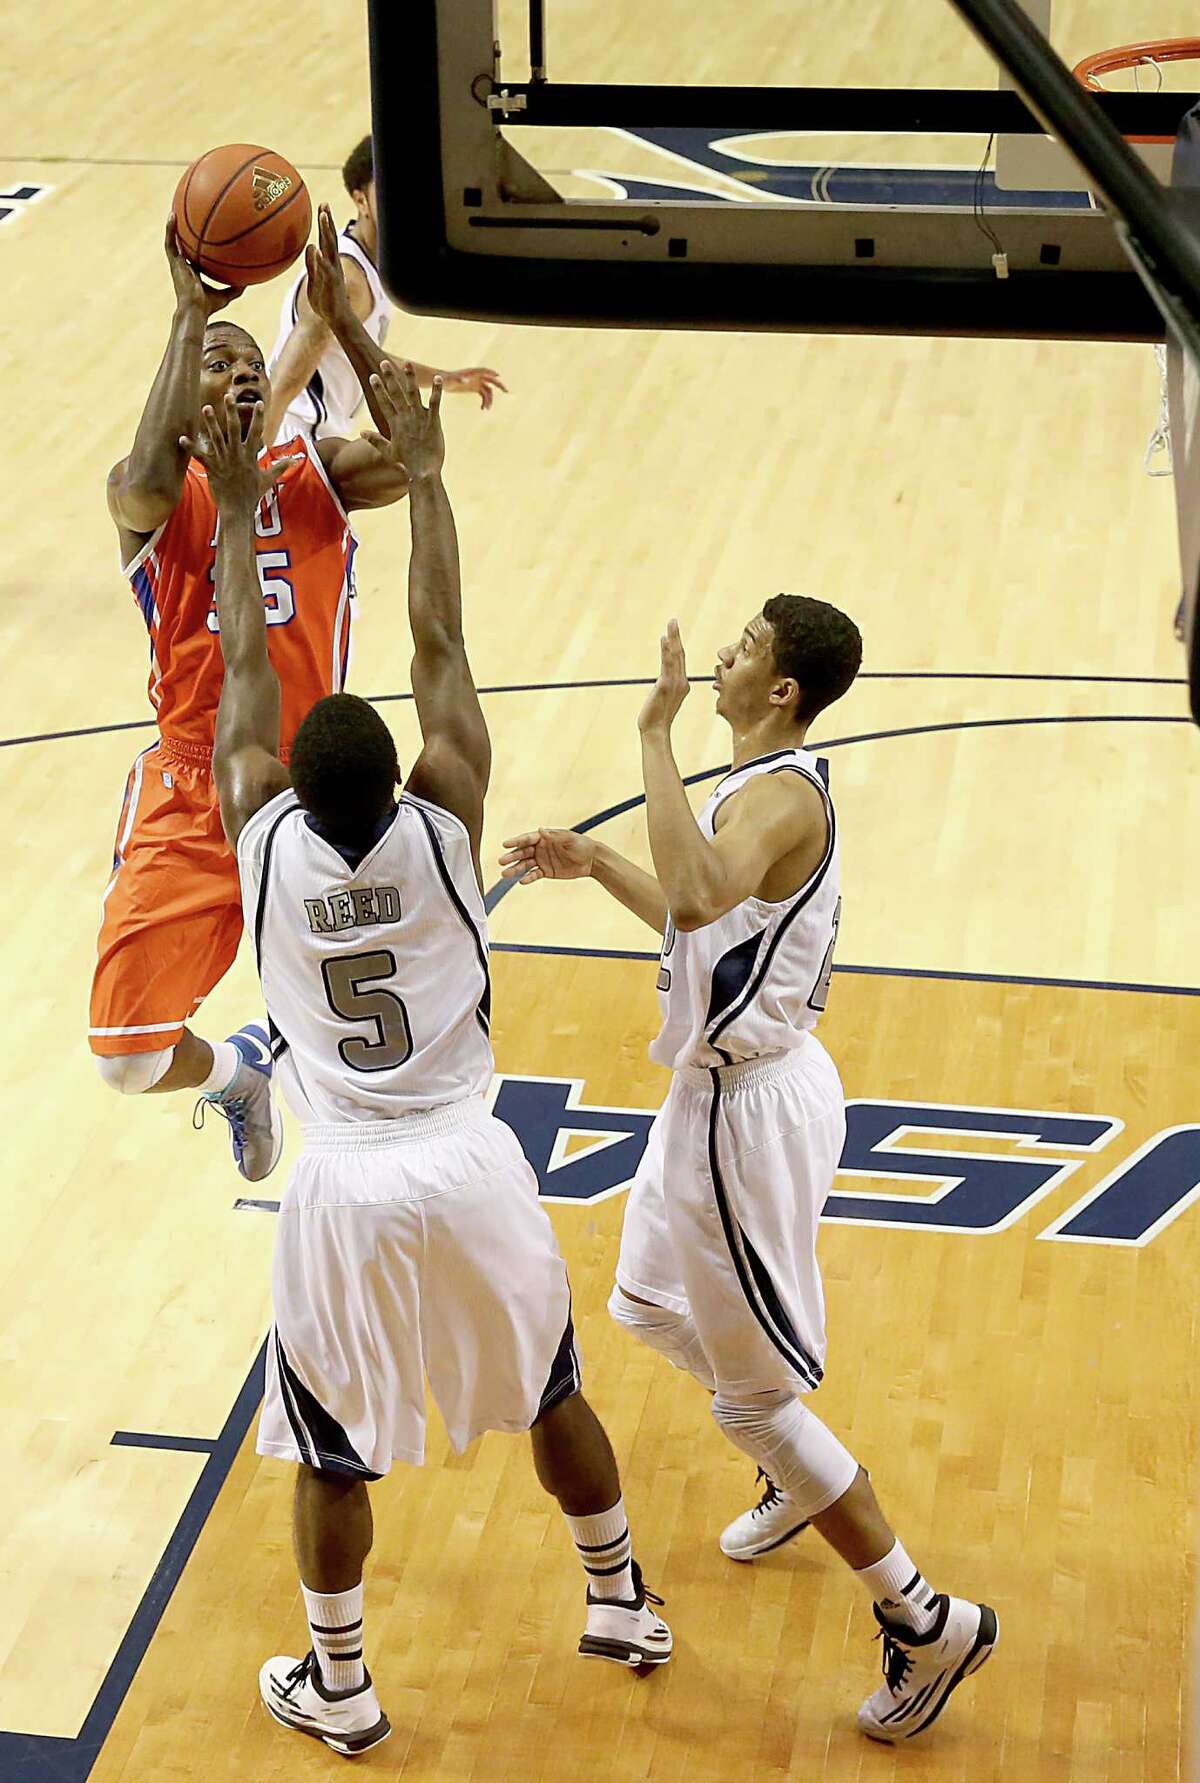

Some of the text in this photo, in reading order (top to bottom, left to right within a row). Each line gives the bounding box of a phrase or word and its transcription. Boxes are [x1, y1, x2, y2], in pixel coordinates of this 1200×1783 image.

[206, 549, 295, 634] 5
[304, 887, 401, 932] REED
[321, 948, 413, 1072] 5
